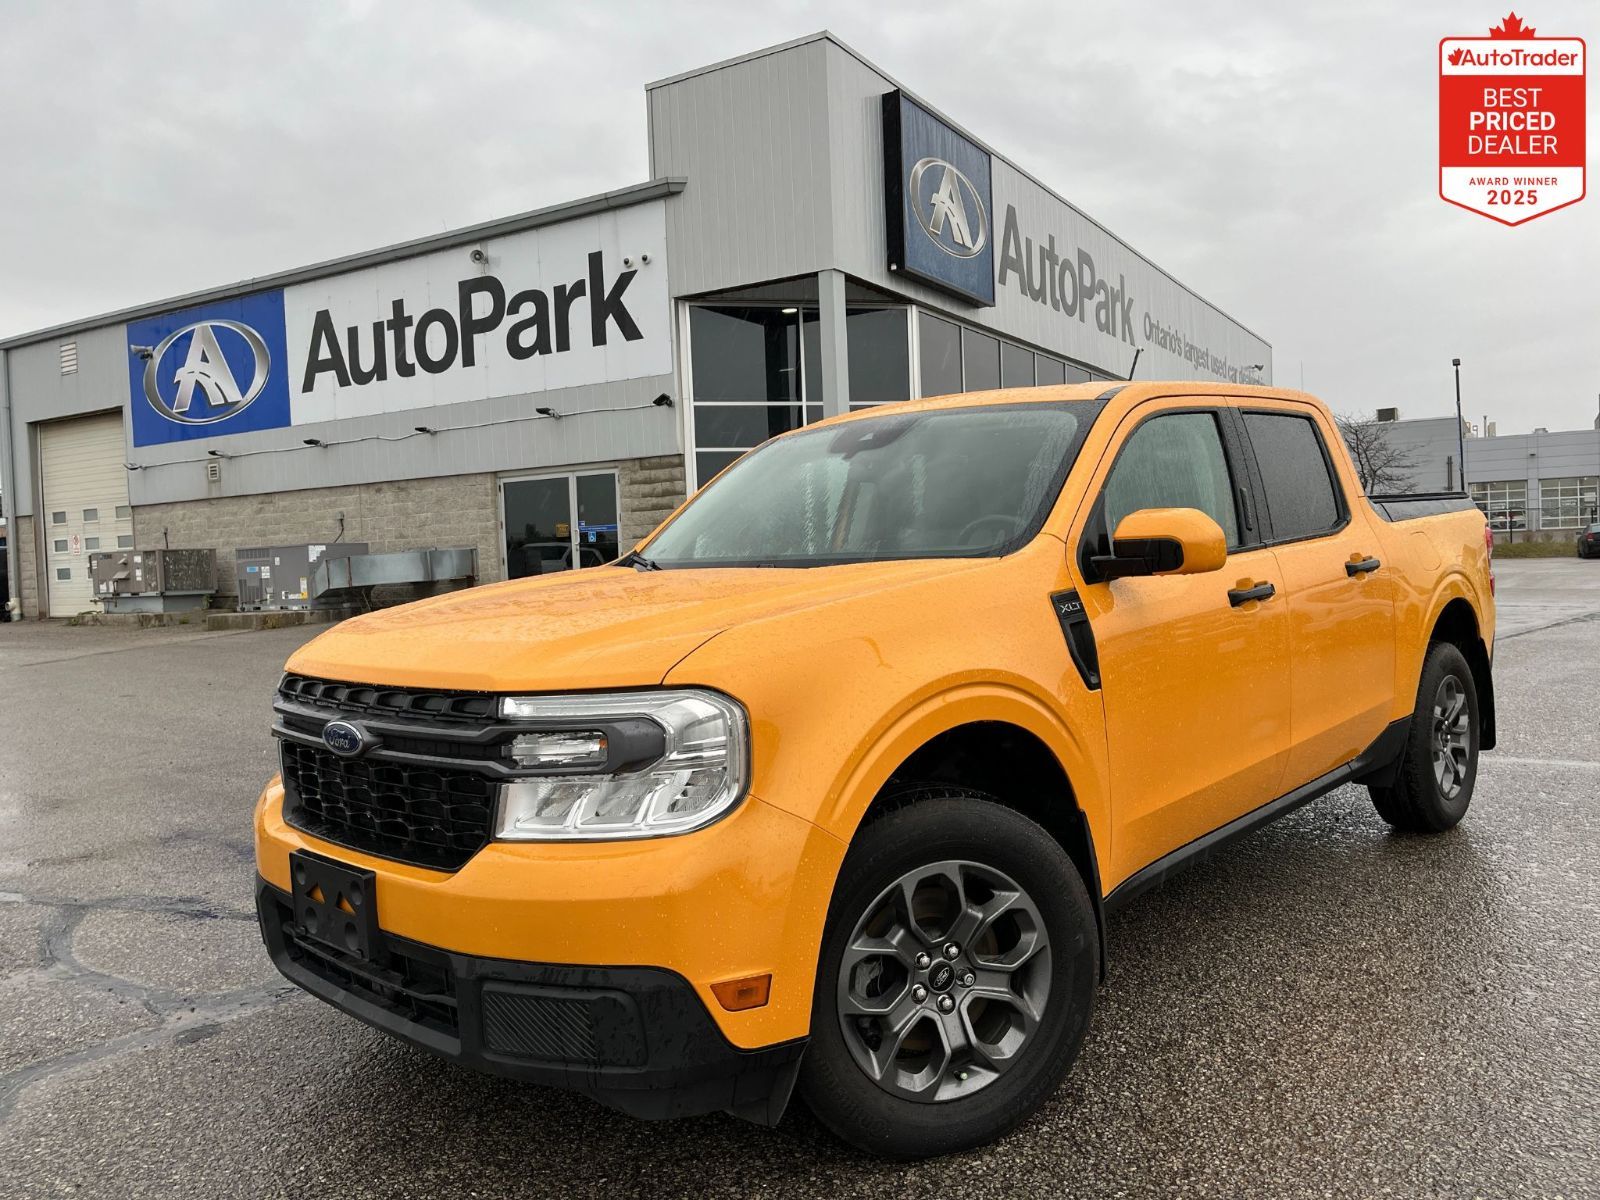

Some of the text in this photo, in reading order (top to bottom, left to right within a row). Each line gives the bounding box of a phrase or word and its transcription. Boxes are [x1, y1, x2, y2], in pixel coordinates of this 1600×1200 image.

[301, 250, 643, 394] AutoPark
[998, 203, 1136, 346] AutoPark
[1144, 312, 1183, 357] Ontario's
[1183, 333, 1209, 370] largest
[1211, 356, 1227, 379] used
[1059, 602, 1080, 614] XLT
[327, 725, 351, 749] Ford
